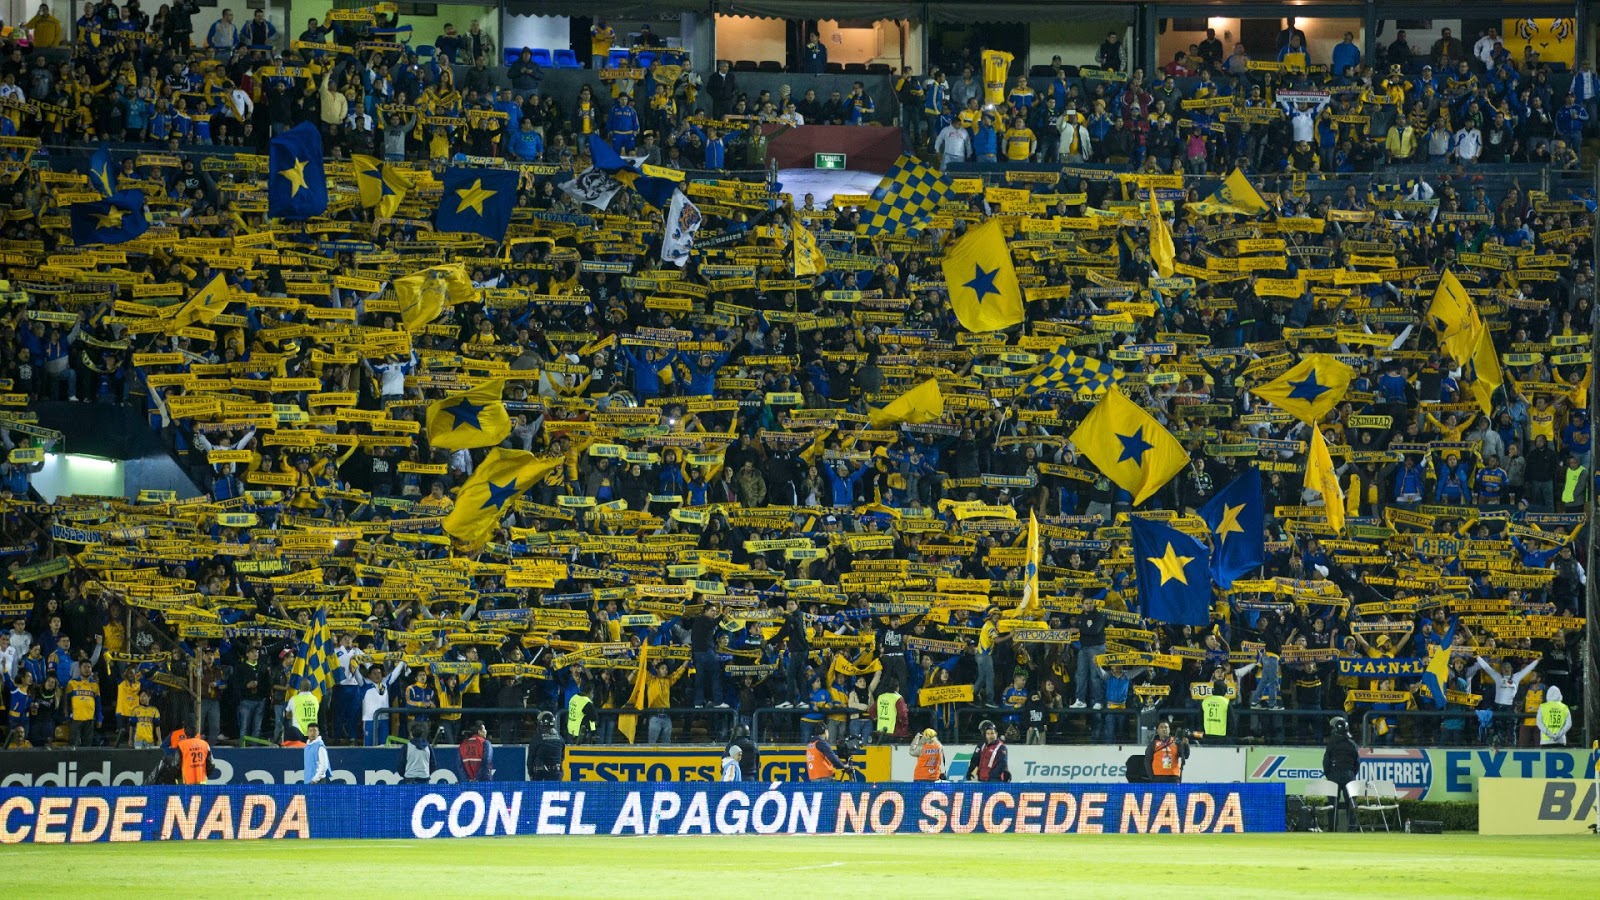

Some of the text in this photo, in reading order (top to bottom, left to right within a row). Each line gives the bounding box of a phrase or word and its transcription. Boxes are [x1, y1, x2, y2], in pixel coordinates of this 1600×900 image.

[1349, 416, 1392, 428] SKINHEAD
[303, 707, 316, 718] 109
[1208, 708, 1218, 718] 61
[191, 752, 203, 763] 29
[1023, 760, 1127, 780] Transportes
[411, 781, 1244, 838] CON EL APAGÓN NO SUCEDE NADA
[0, 796, 148, 842] CEDE
[161, 795, 310, 841] NADA
